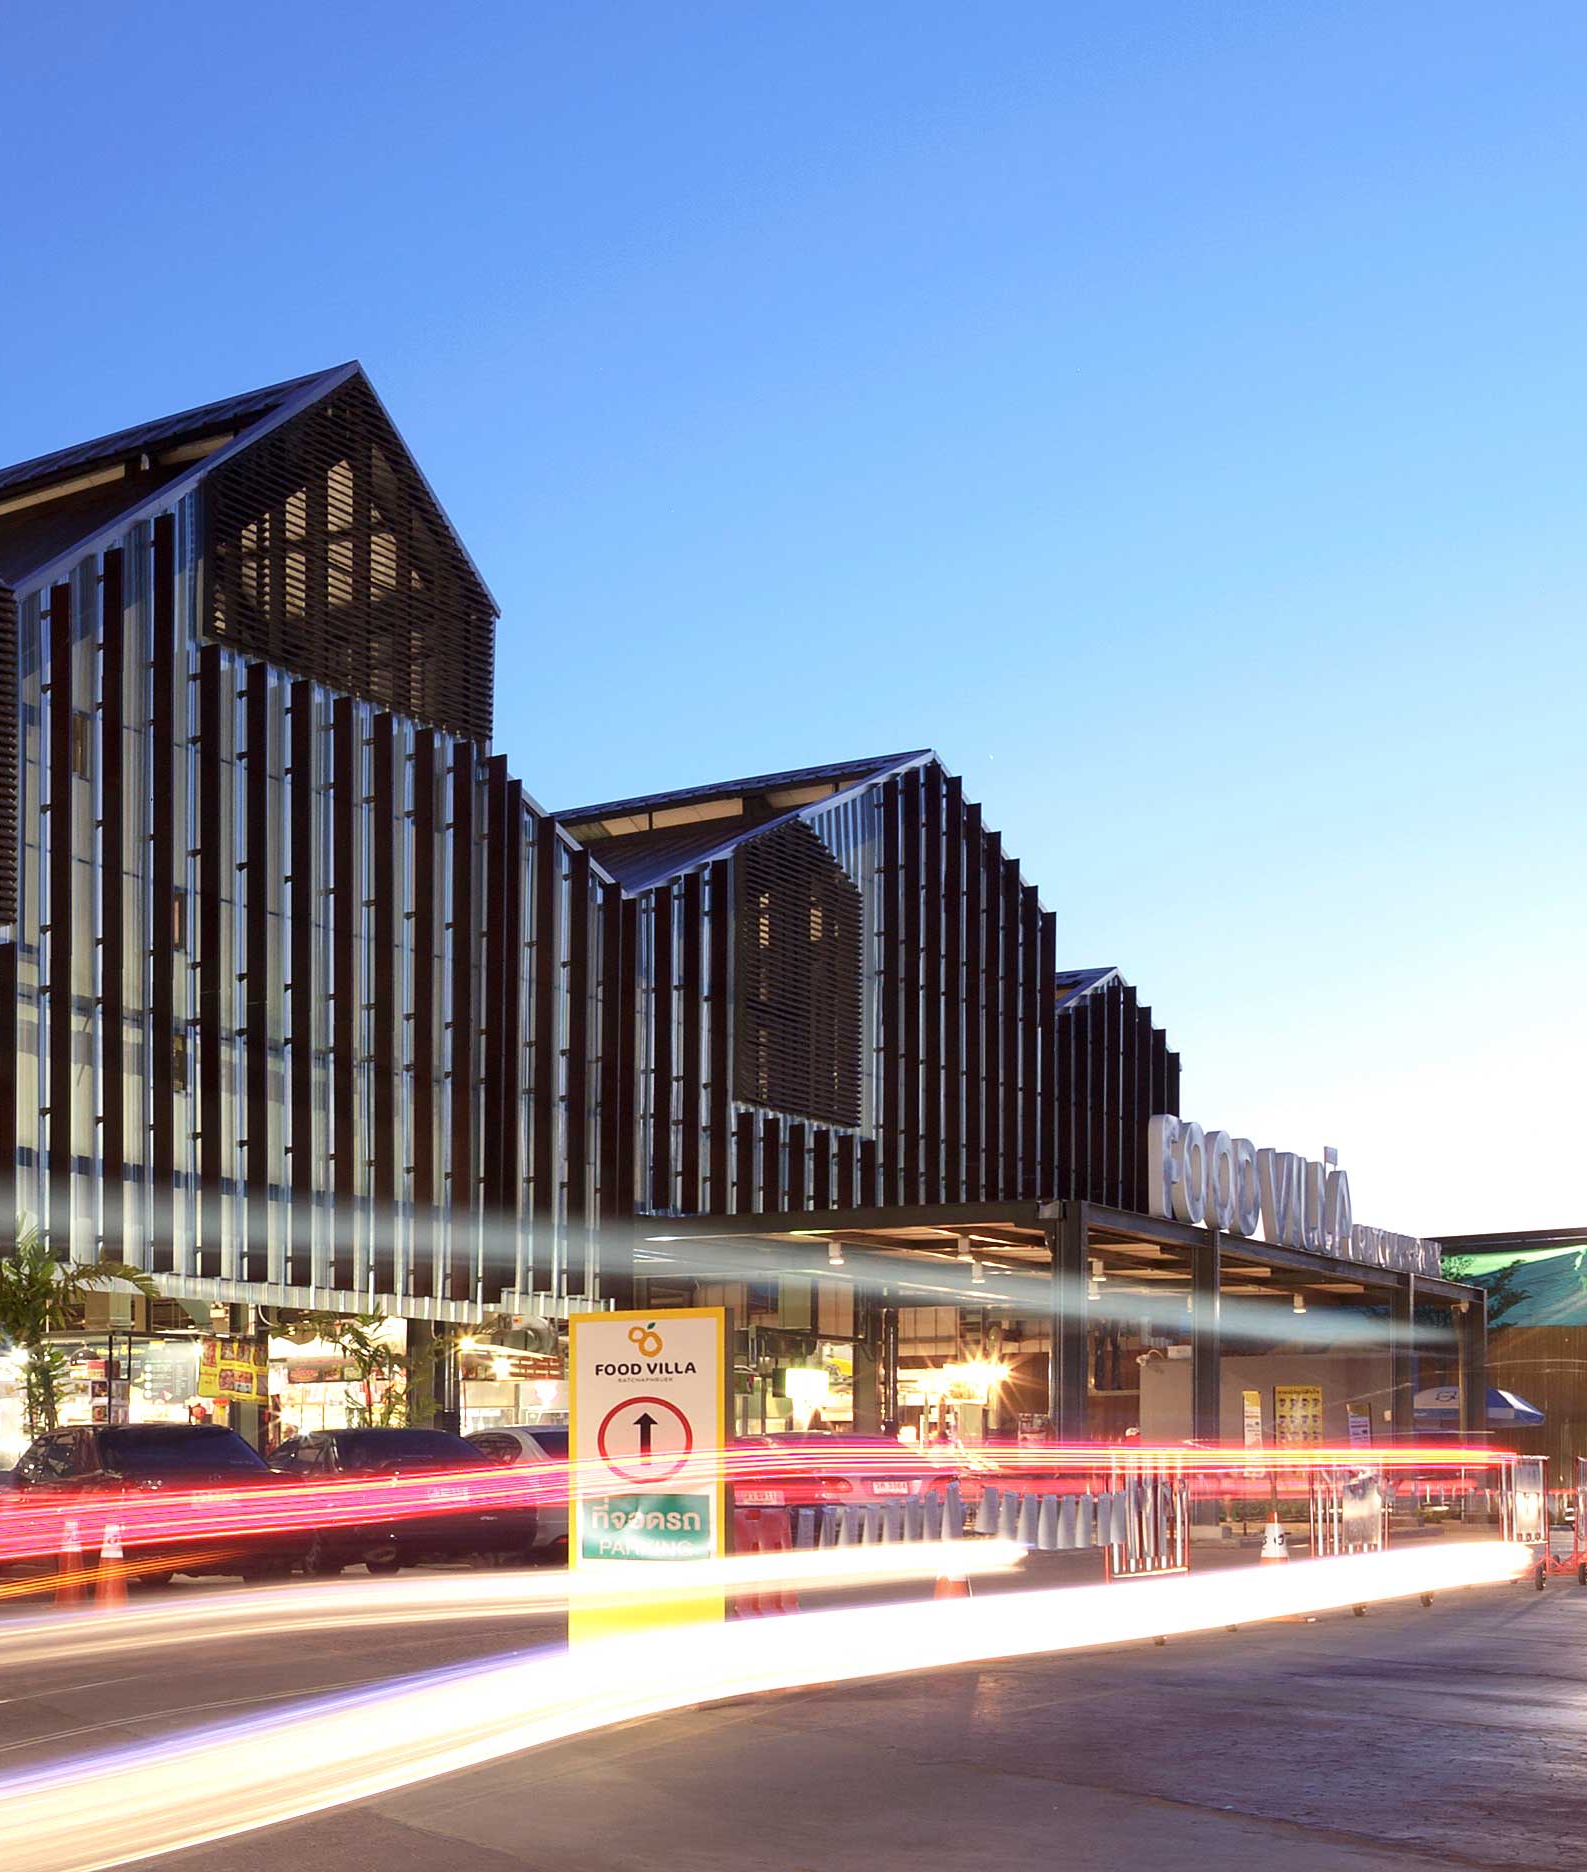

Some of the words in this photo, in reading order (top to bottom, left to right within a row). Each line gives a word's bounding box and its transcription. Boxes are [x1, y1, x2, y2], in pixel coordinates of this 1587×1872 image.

[1147, 1113, 1261, 1237] FOOD
[595, 1363, 642, 1377] FOOD
[646, 1362, 697, 1375] VILLA
[592, 1496, 701, 1531] ที่จอดรถ
